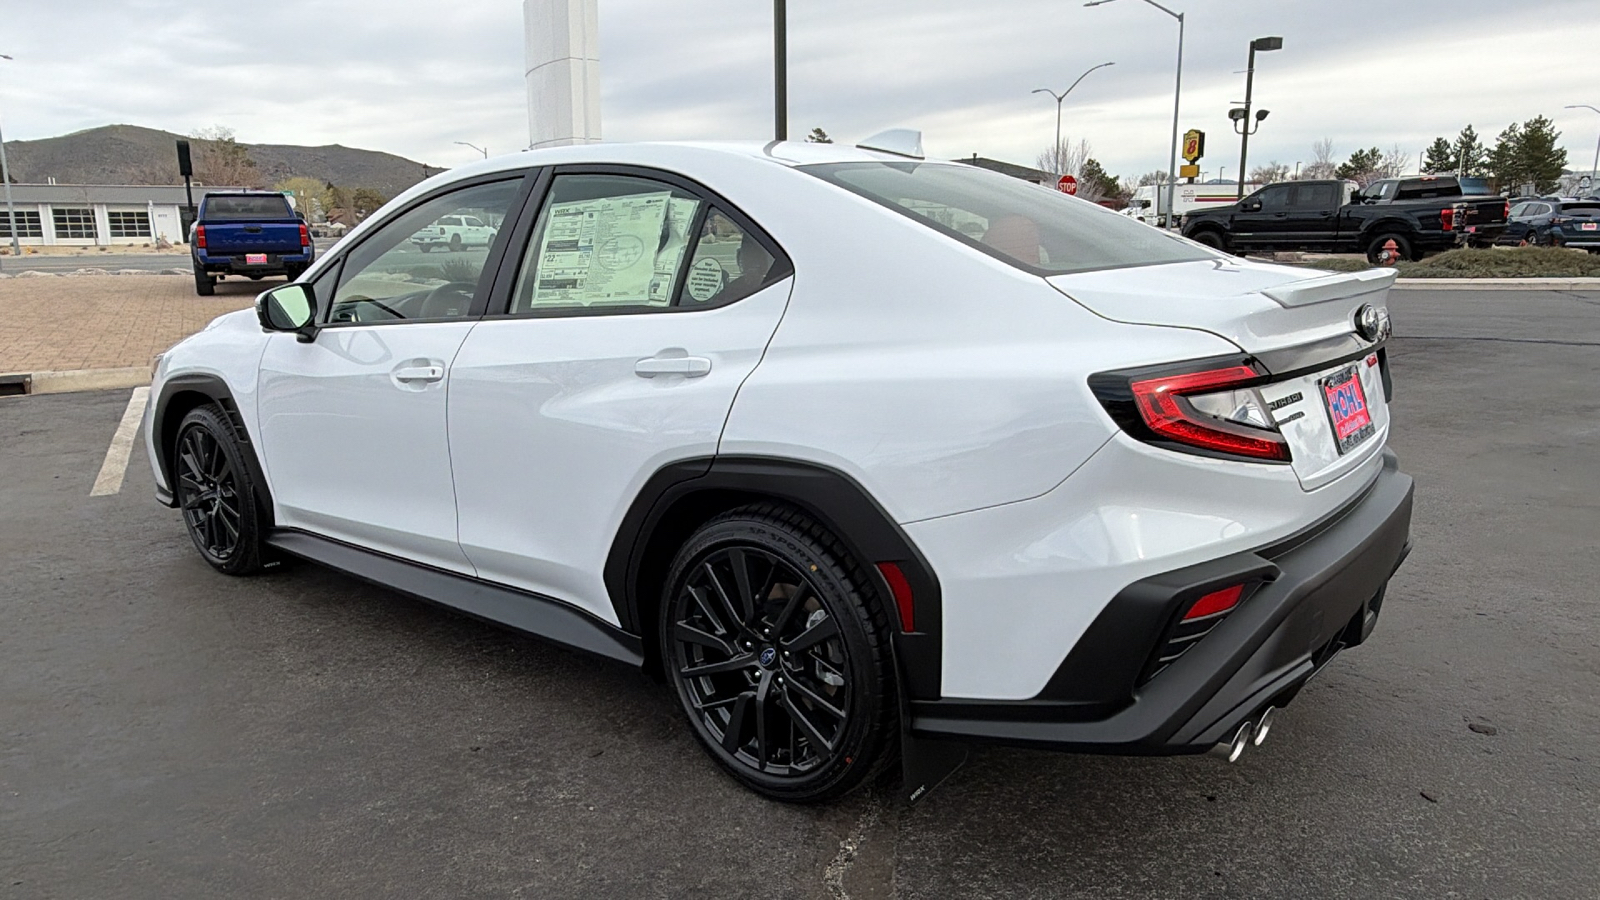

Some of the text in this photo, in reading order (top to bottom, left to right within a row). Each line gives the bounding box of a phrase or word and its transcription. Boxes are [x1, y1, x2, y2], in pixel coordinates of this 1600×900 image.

[1186, 140, 1197, 155] 8
[1059, 182, 1077, 192] STOP
[1329, 384, 1363, 423] HOHL
[769, 532, 812, 564] SPORT
